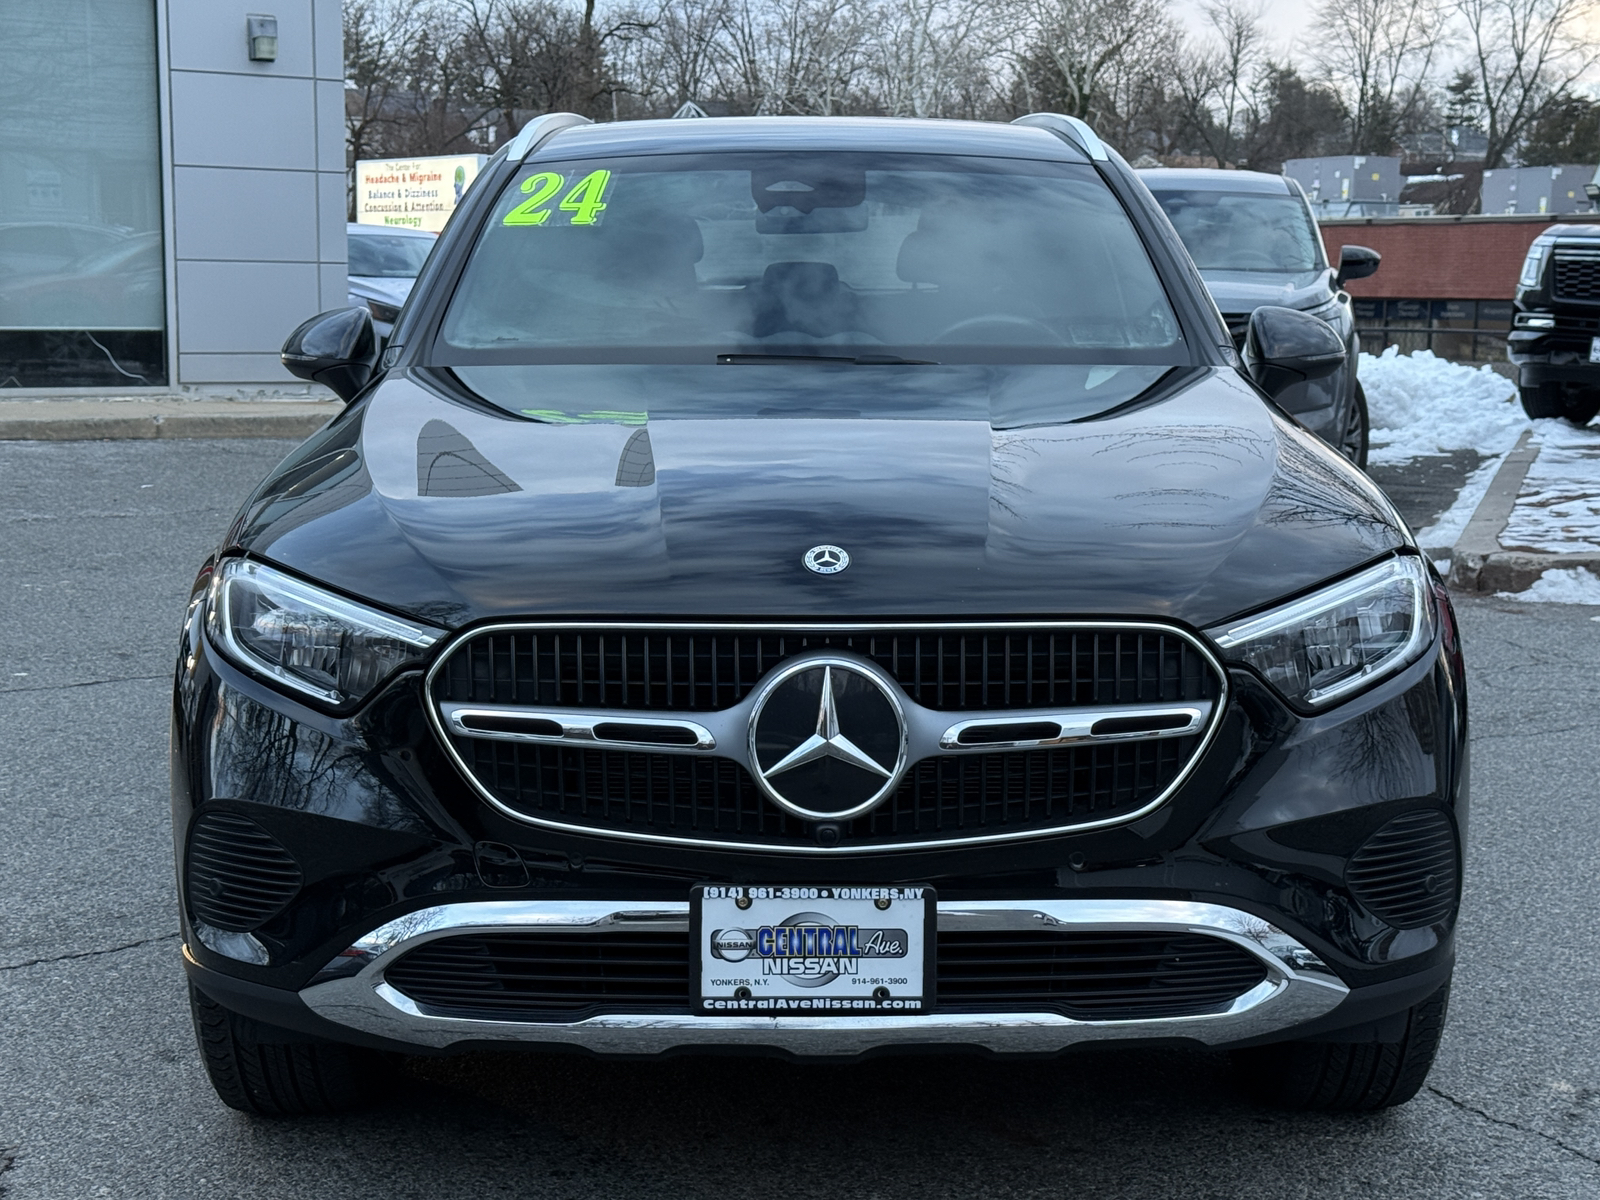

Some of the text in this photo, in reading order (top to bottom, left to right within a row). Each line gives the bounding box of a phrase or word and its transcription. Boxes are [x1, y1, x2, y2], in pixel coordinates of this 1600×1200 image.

[365, 170, 442, 185] Headache & Migraine
[368, 187, 438, 199] Balance & Dizziness
[502, 169, 611, 226] 24
[364, 199, 444, 212] Concussion & Attention
[384, 214, 423, 227] Neurology
[748, 888, 819, 899] 961-3900
[756, 925, 863, 957] CENTRAL
[762, 957, 858, 975] NISSAN
[710, 979, 753, 987] YONKERS,
[703, 998, 922, 1009] CentralAveNissan.com
